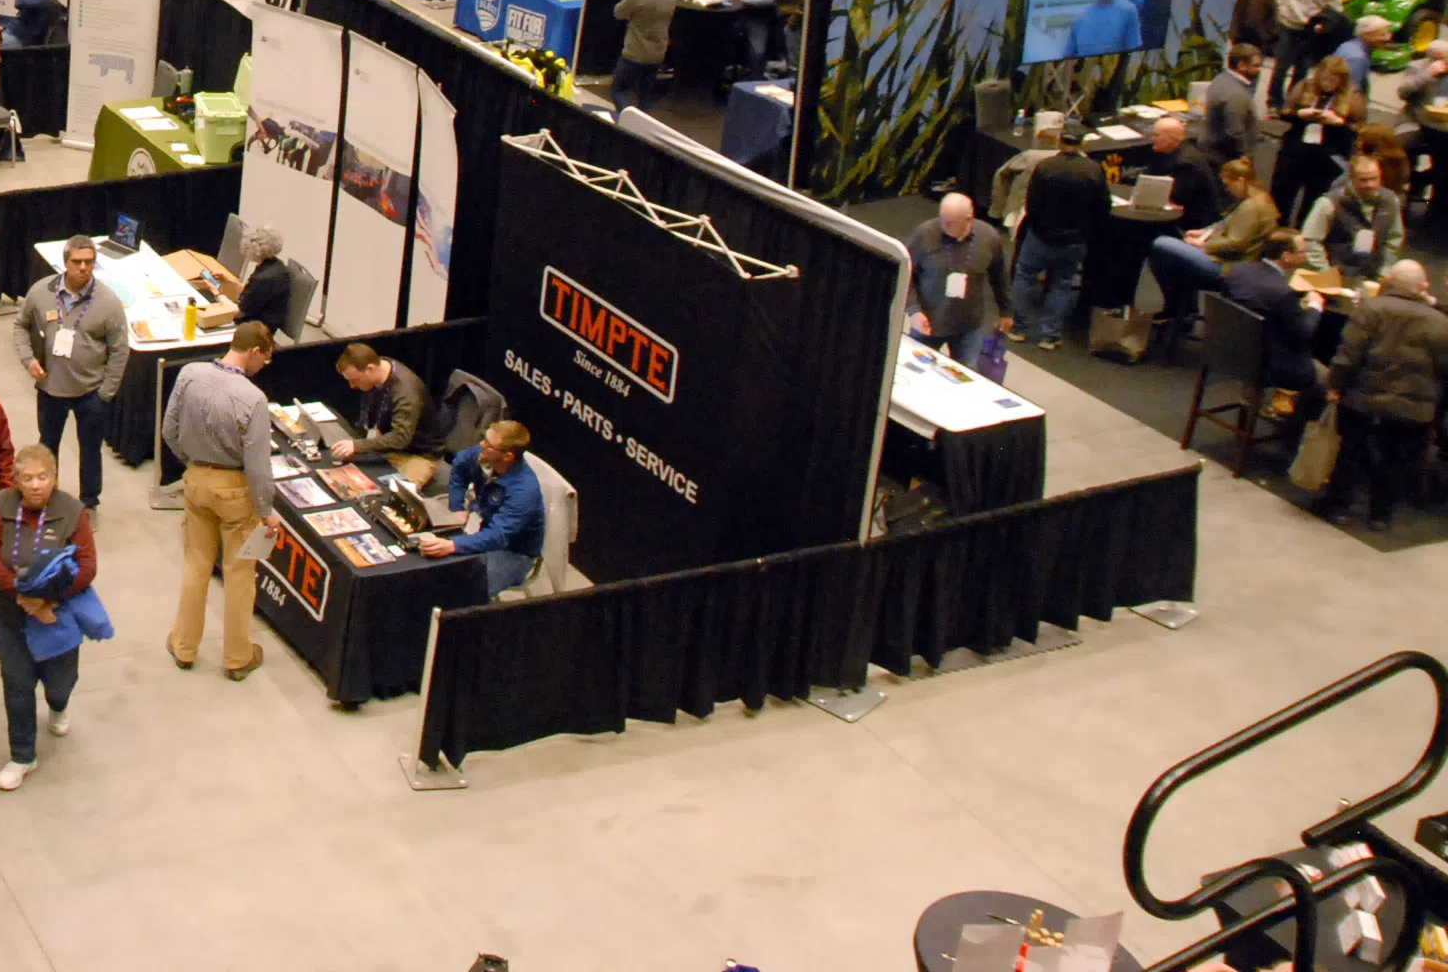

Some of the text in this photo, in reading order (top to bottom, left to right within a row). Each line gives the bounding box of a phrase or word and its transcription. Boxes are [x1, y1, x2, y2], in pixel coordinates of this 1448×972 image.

[552, 278, 669, 391] TIMPTE
[573, 348, 632, 398] Since 1884
[504, 348, 699, 505] SALES PARTS SERVICE
[260, 575, 287, 607] 1884
